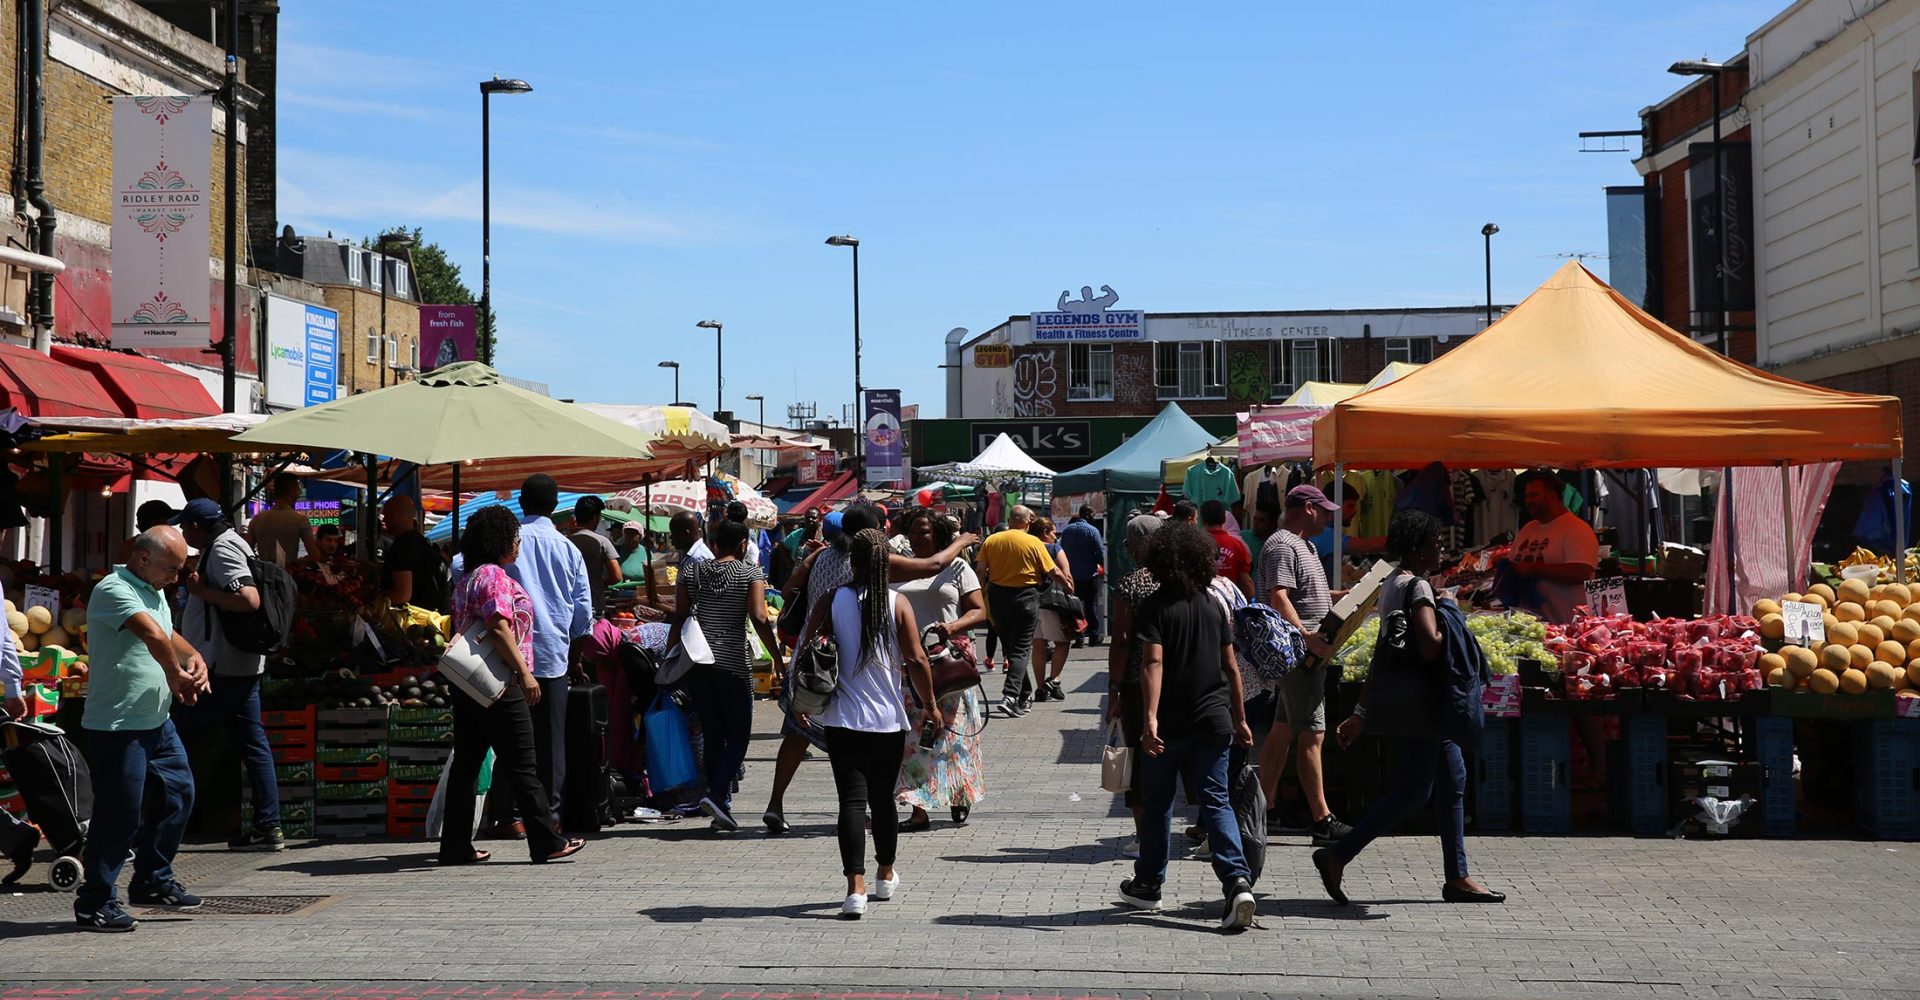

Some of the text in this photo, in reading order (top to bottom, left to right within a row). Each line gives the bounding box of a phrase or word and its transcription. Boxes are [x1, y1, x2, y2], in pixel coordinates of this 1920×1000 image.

[122, 194, 200, 203] RIDLEY ROAD
[430, 319, 465, 327] fresh fish
[1036, 313, 1138, 326] LEGENDS GYM
[1036, 327, 1139, 340] Health & Fitness Centre
[1220, 326, 1328, 338] FITNESS CENTER
[271, 341, 304, 362] Lycamobile
[294, 501, 340, 510] BILE PHONE
[308, 518, 340, 526] EPAIRS
